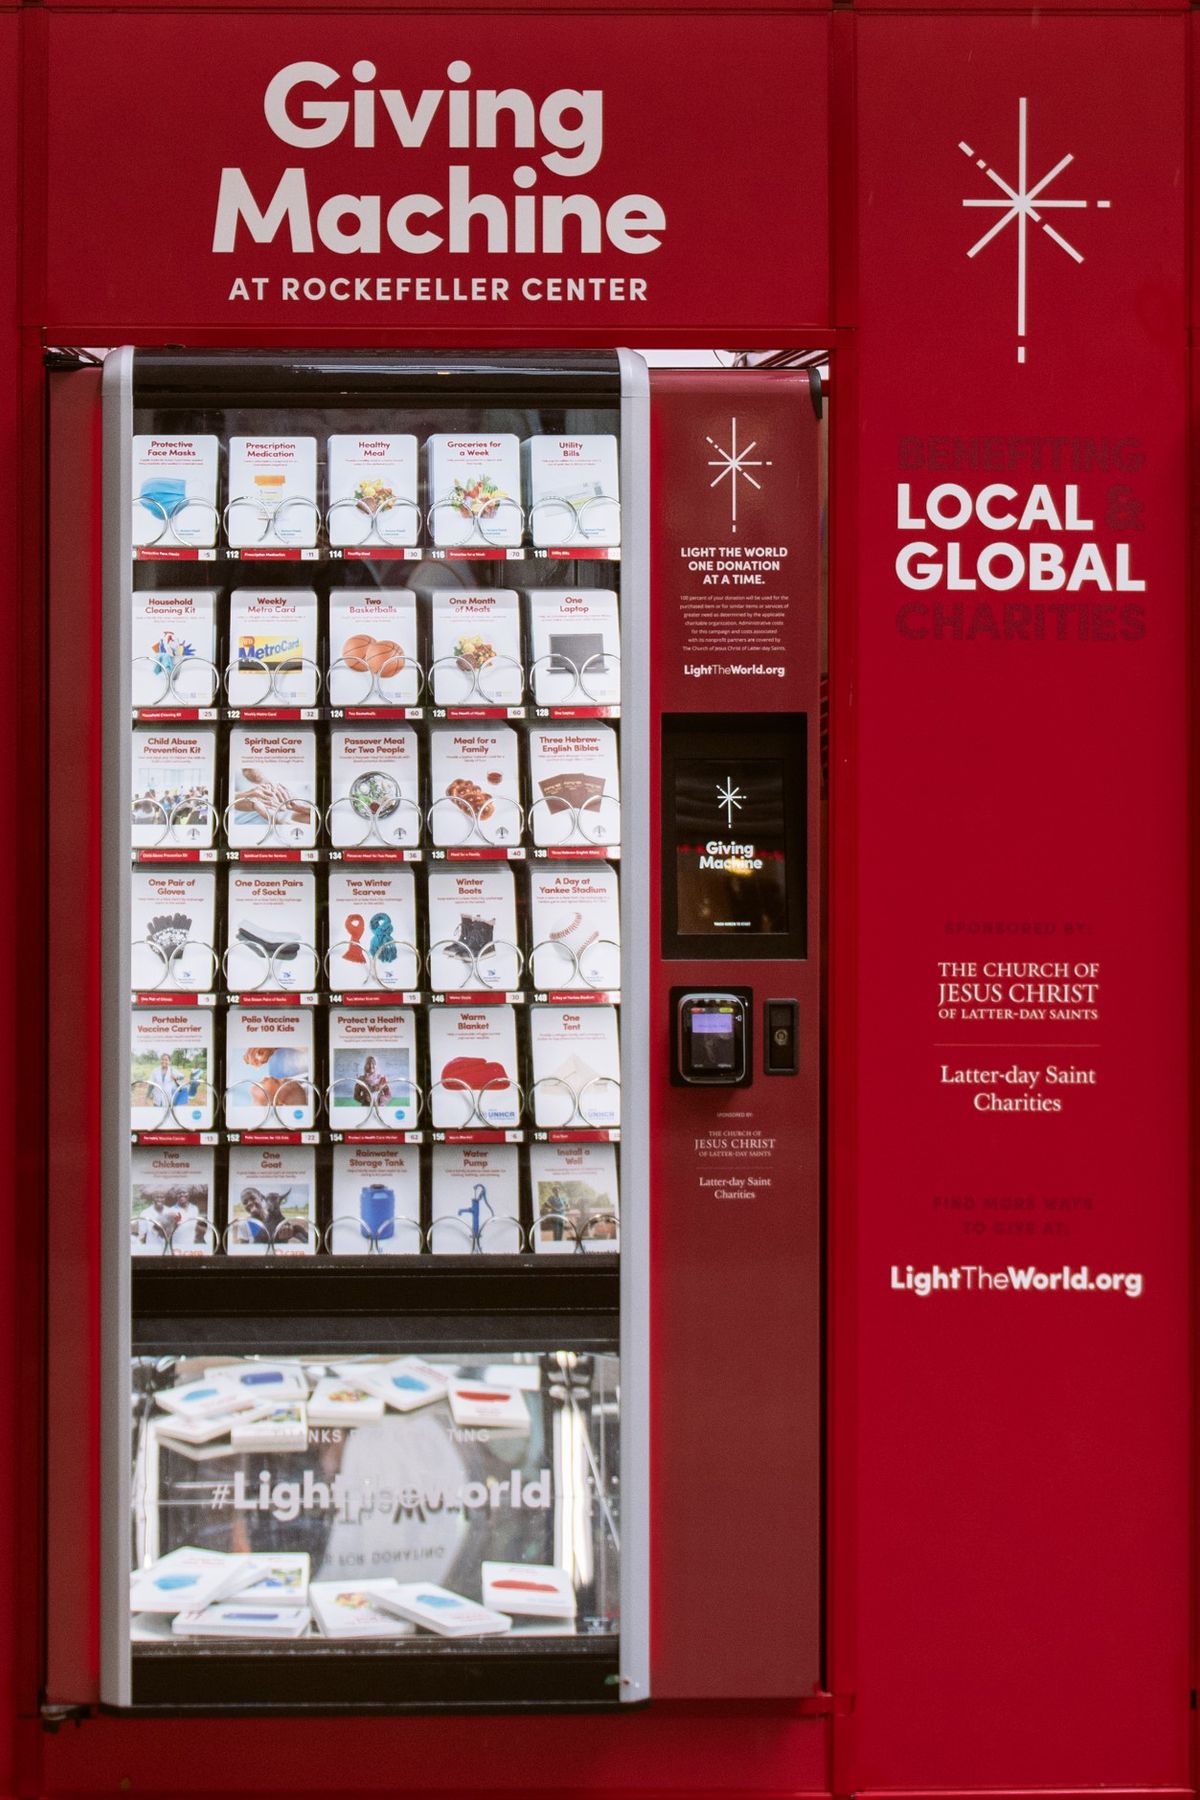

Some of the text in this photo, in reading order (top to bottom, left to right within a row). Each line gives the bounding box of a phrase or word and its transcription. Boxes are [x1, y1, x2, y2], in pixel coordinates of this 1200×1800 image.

[264, 59, 604, 177] Giving
[212, 165, 666, 254] Machine
[228, 277, 648, 300] AT ROCKEFELLER CENTER
[150, 440, 193, 448] Protective
[245, 442, 296, 450] Prescription
[358, 441, 390, 450] Healthy
[559, 442, 583, 450] Utility
[363, 449, 385, 457] Meal
[897, 436, 1146, 472] BENEFITING
[897, 483, 1145, 530] LOCAL &
[680, 547, 788, 557] LIGHT THE WORLD
[688, 561, 780, 571] ONE DONATION
[895, 541, 1146, 592] GLOBAL
[703, 575, 765, 584] AT A TIME.
[257, 598, 287, 606] Weekly
[145, 607, 182, 615] Cleaning
[560, 605, 589, 613] Laptop
[895, 602, 1147, 641] CHARITIES
[239, 639, 300, 660] MetroCard
[684, 664, 785, 677] LightTheWorld.org
[227, 710, 240, 718] 122
[245, 737, 302, 746] Spiritual Care
[377, 746, 405, 754] People
[462, 745, 488, 753] Family
[542, 745, 572, 753] English
[705, 841, 754, 857] Giving
[699, 856, 763, 870] Machine
[456, 878, 483, 886] Winter
[563, 878, 579, 886] Day
[944, 921, 1093, 935] SPONSORED BY:
[938, 962, 1099, 977] THE CHURCH OF
[939, 984, 1098, 1006] JESUS CHRIST
[938, 1009, 1098, 1019] OF LATTER-DAY SAINTS
[277, 1024, 294, 1032] Kids
[345, 1024, 366, 1032] Care
[458, 1022, 489, 1030] Blanket
[941, 1065, 1095, 1089] Latter-day Saint
[973, 1092, 1062, 1112] Charities
[695, 1139, 776, 1149] JESUS CHRIST
[152, 1160, 189, 1169] Chickens
[261, 1160, 281, 1169] Goat
[349, 1158, 404, 1167] Storage Tank
[463, 1159, 487, 1168] Pump
[700, 1177, 771, 1188] Latter-day Saint
[714, 1190, 756, 1199] Charities
[890, 1265, 1143, 1297] LightTheWorld.org
